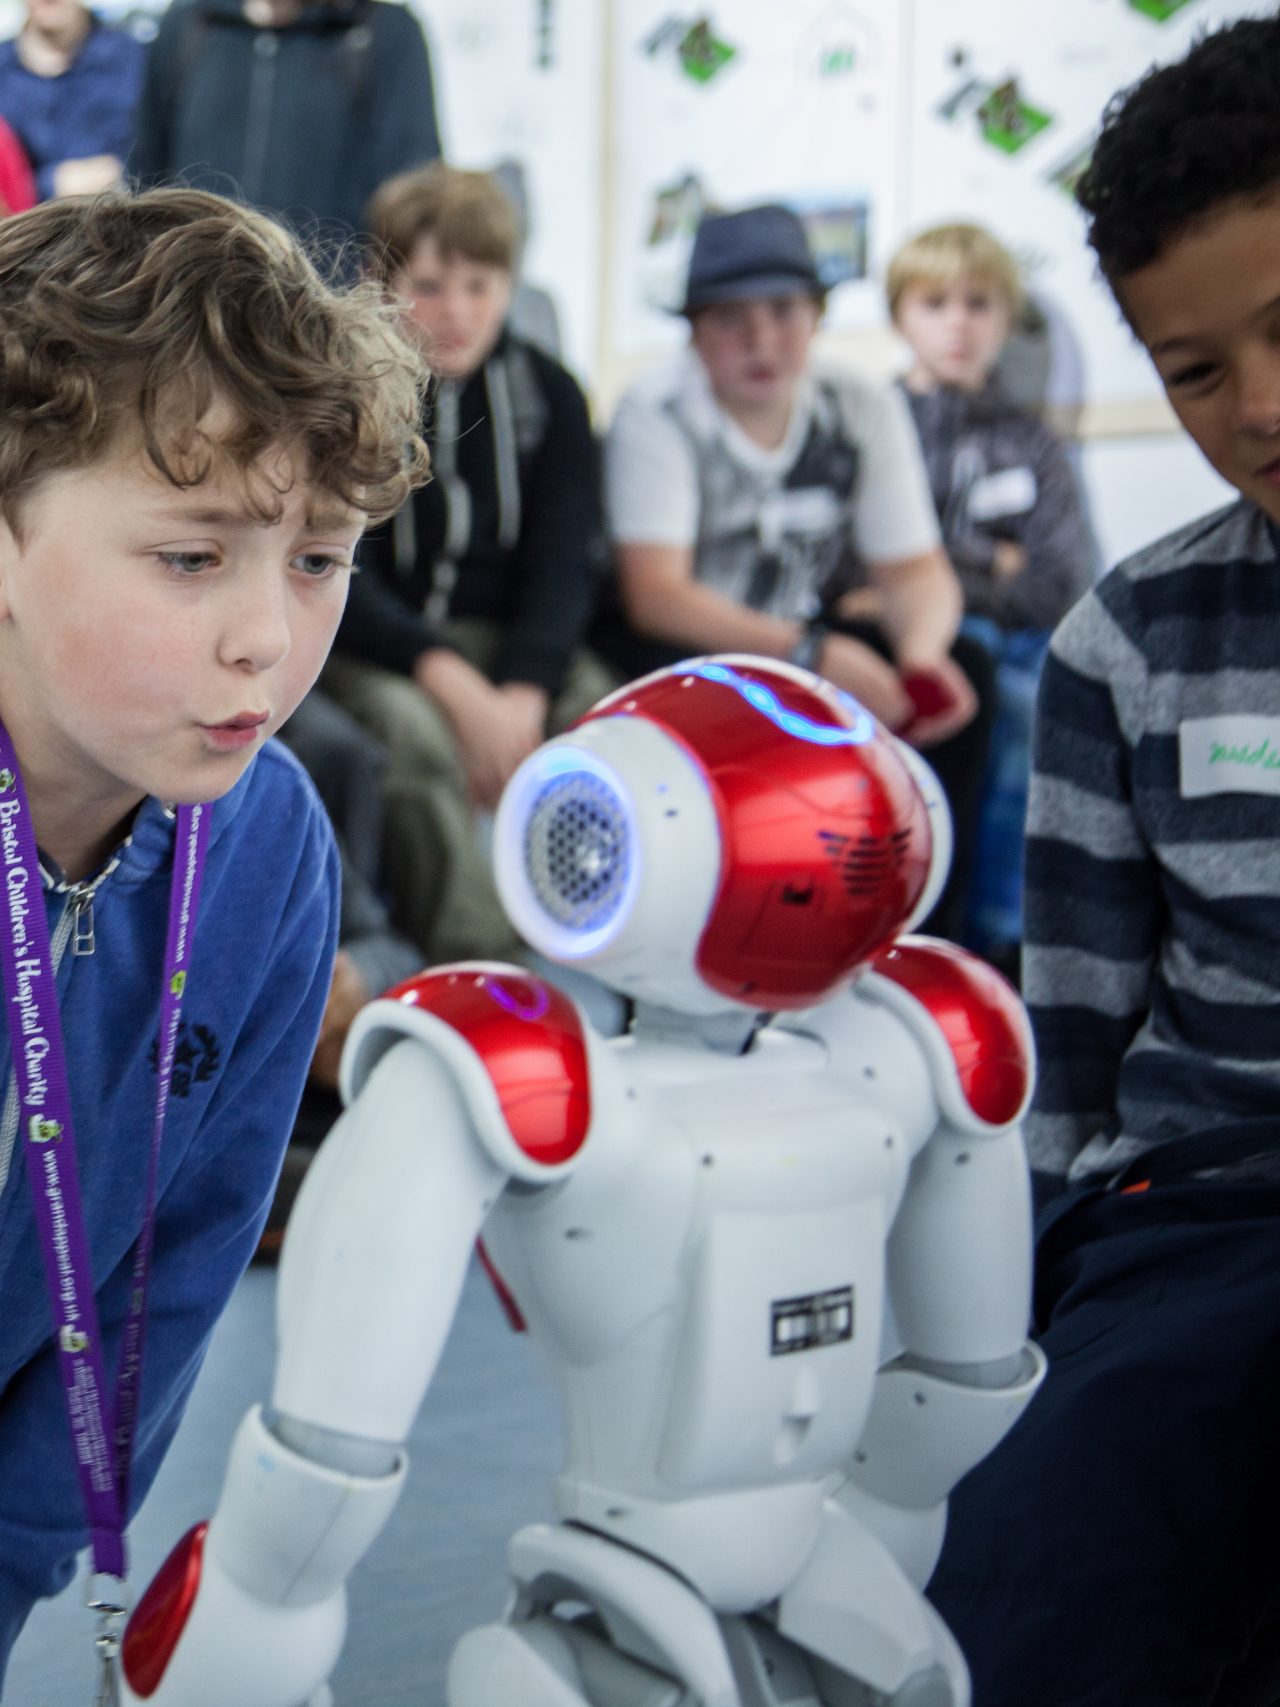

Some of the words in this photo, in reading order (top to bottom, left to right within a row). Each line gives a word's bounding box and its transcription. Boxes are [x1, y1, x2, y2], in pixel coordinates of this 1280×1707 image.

[6, 866, 35, 958] Children's
[11, 958, 43, 1035] Hospital
[23, 1036, 50, 1106] Charity
[42, 1149, 82, 1322] www.grandappeal.org.uk
